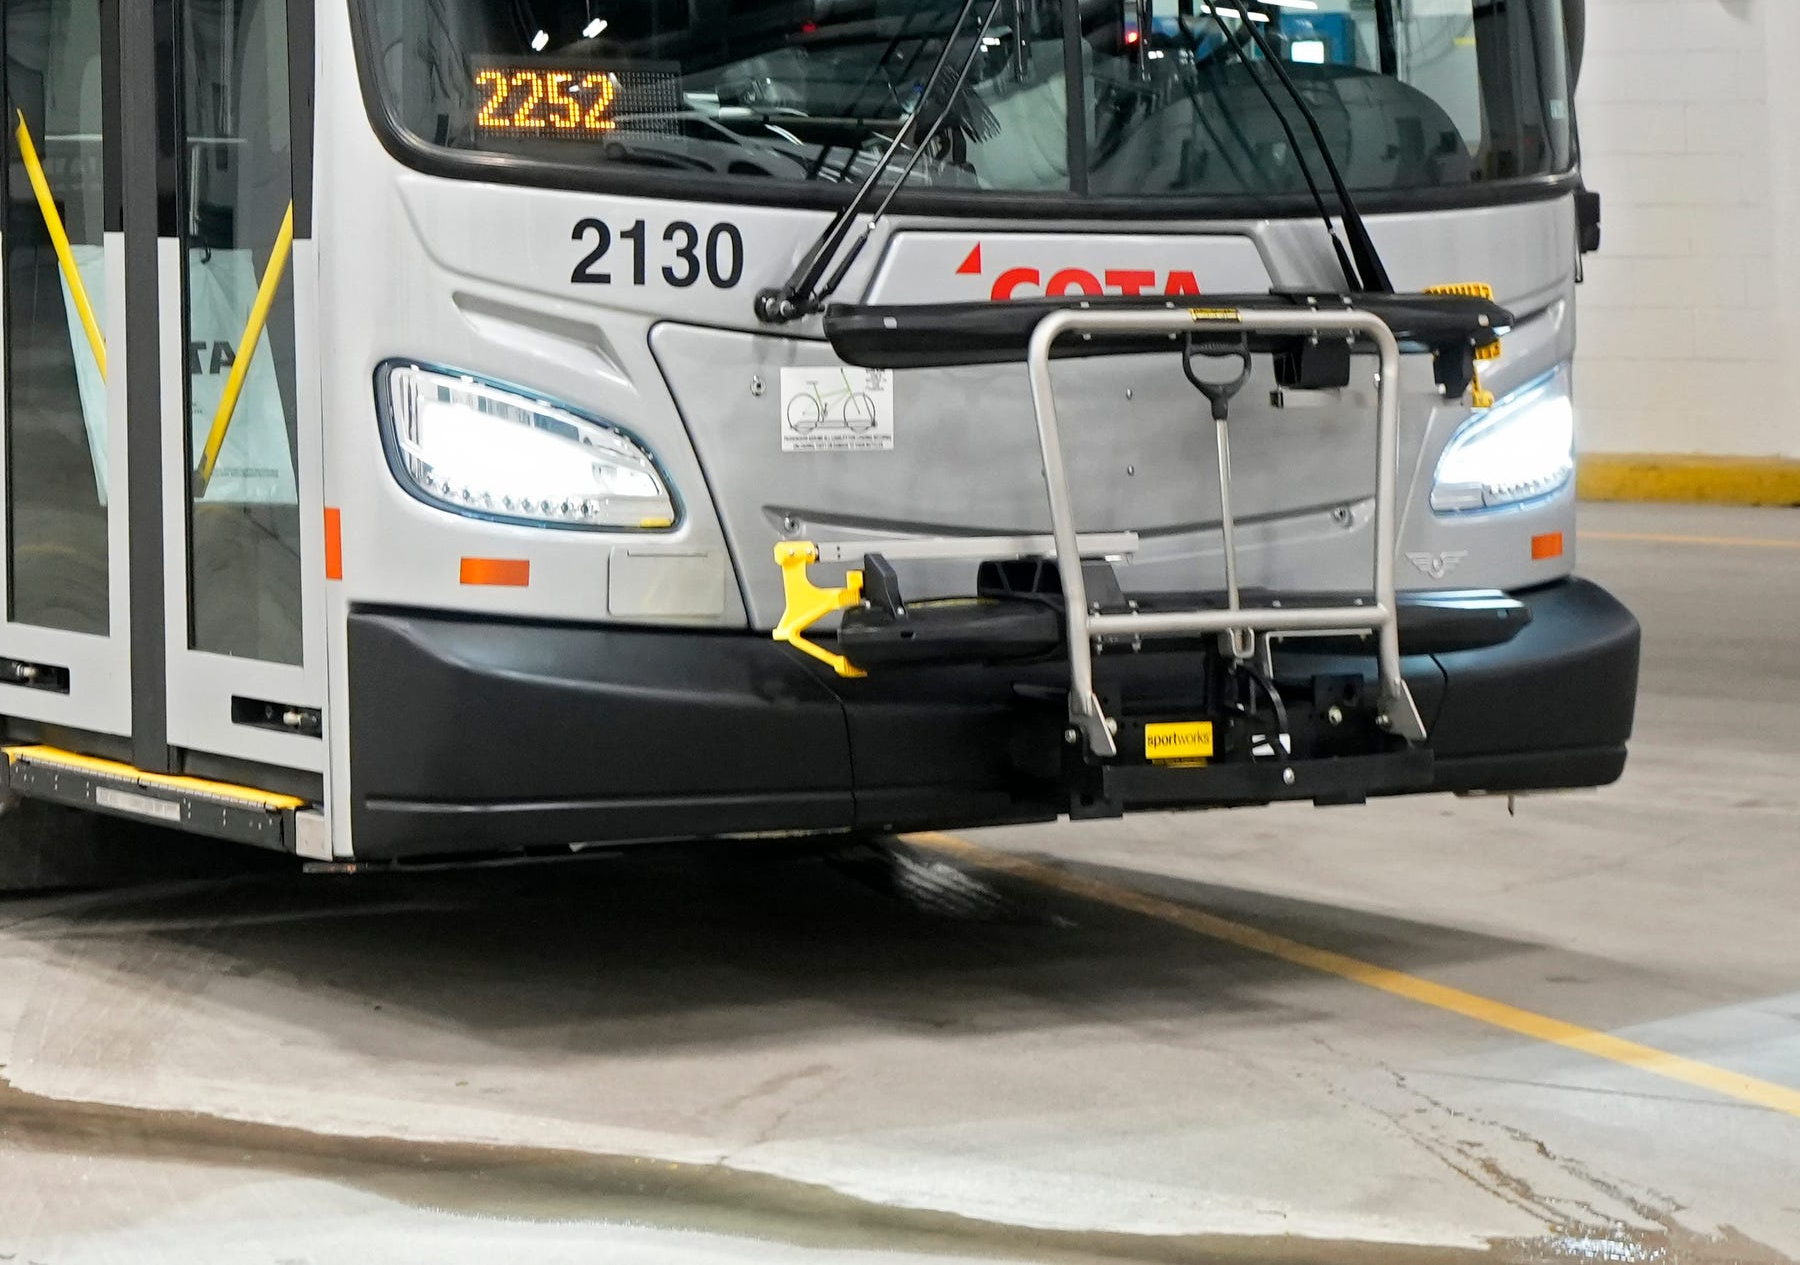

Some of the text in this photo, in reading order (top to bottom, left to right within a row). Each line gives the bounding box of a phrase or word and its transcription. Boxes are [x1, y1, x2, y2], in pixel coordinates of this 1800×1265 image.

[476, 71, 616, 129] 2252
[569, 217, 744, 290] 2130
[1148, 731, 1209, 749] sportworks
